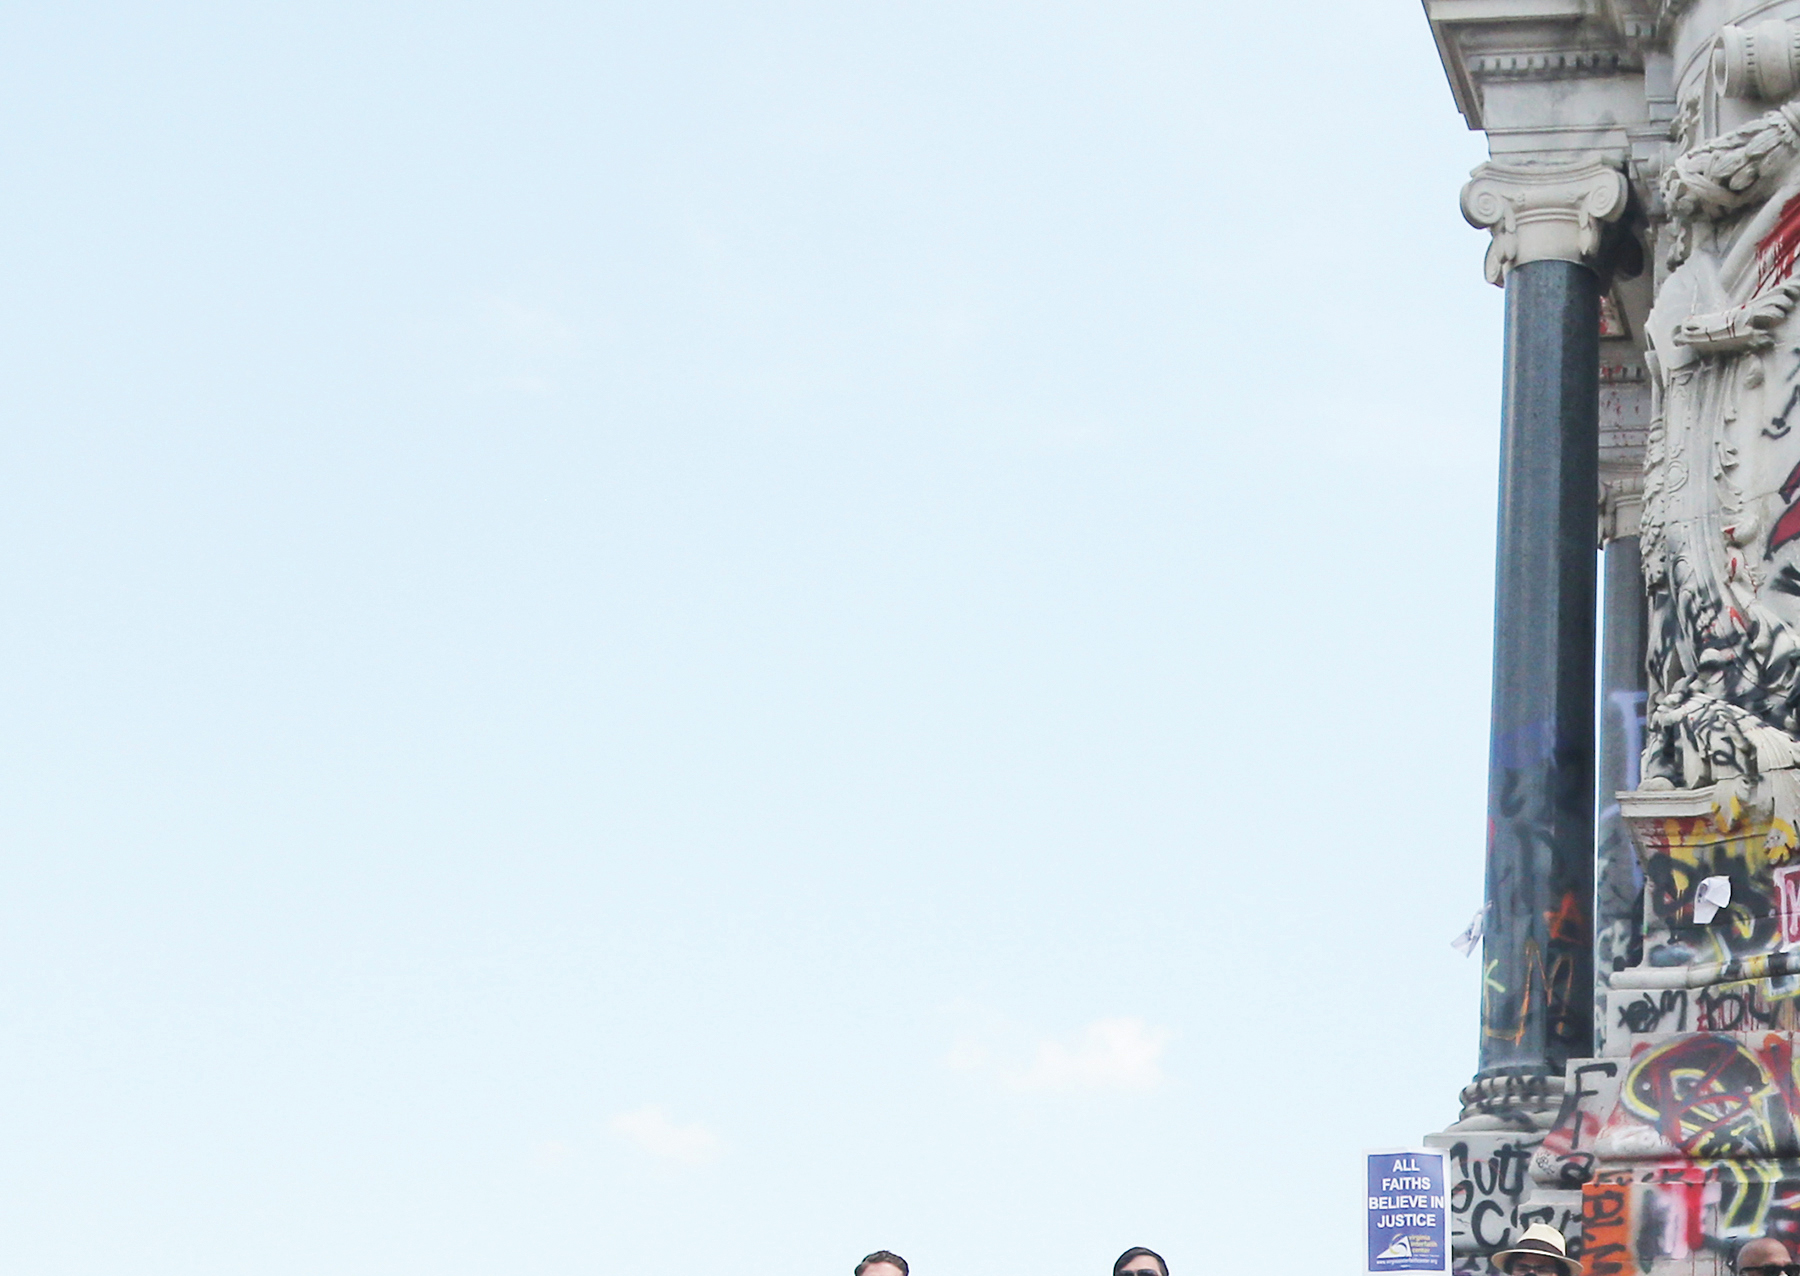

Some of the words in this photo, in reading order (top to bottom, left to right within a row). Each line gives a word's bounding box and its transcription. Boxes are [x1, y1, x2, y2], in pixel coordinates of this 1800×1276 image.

[1392, 1158, 1420, 1172] ALL
[1382, 1176, 1431, 1191] FAITHS
[1368, 1195, 1427, 1211] BELIEVE
[1430, 1195, 1444, 1209] IN
[1377, 1213, 1436, 1229] JUSTICE
